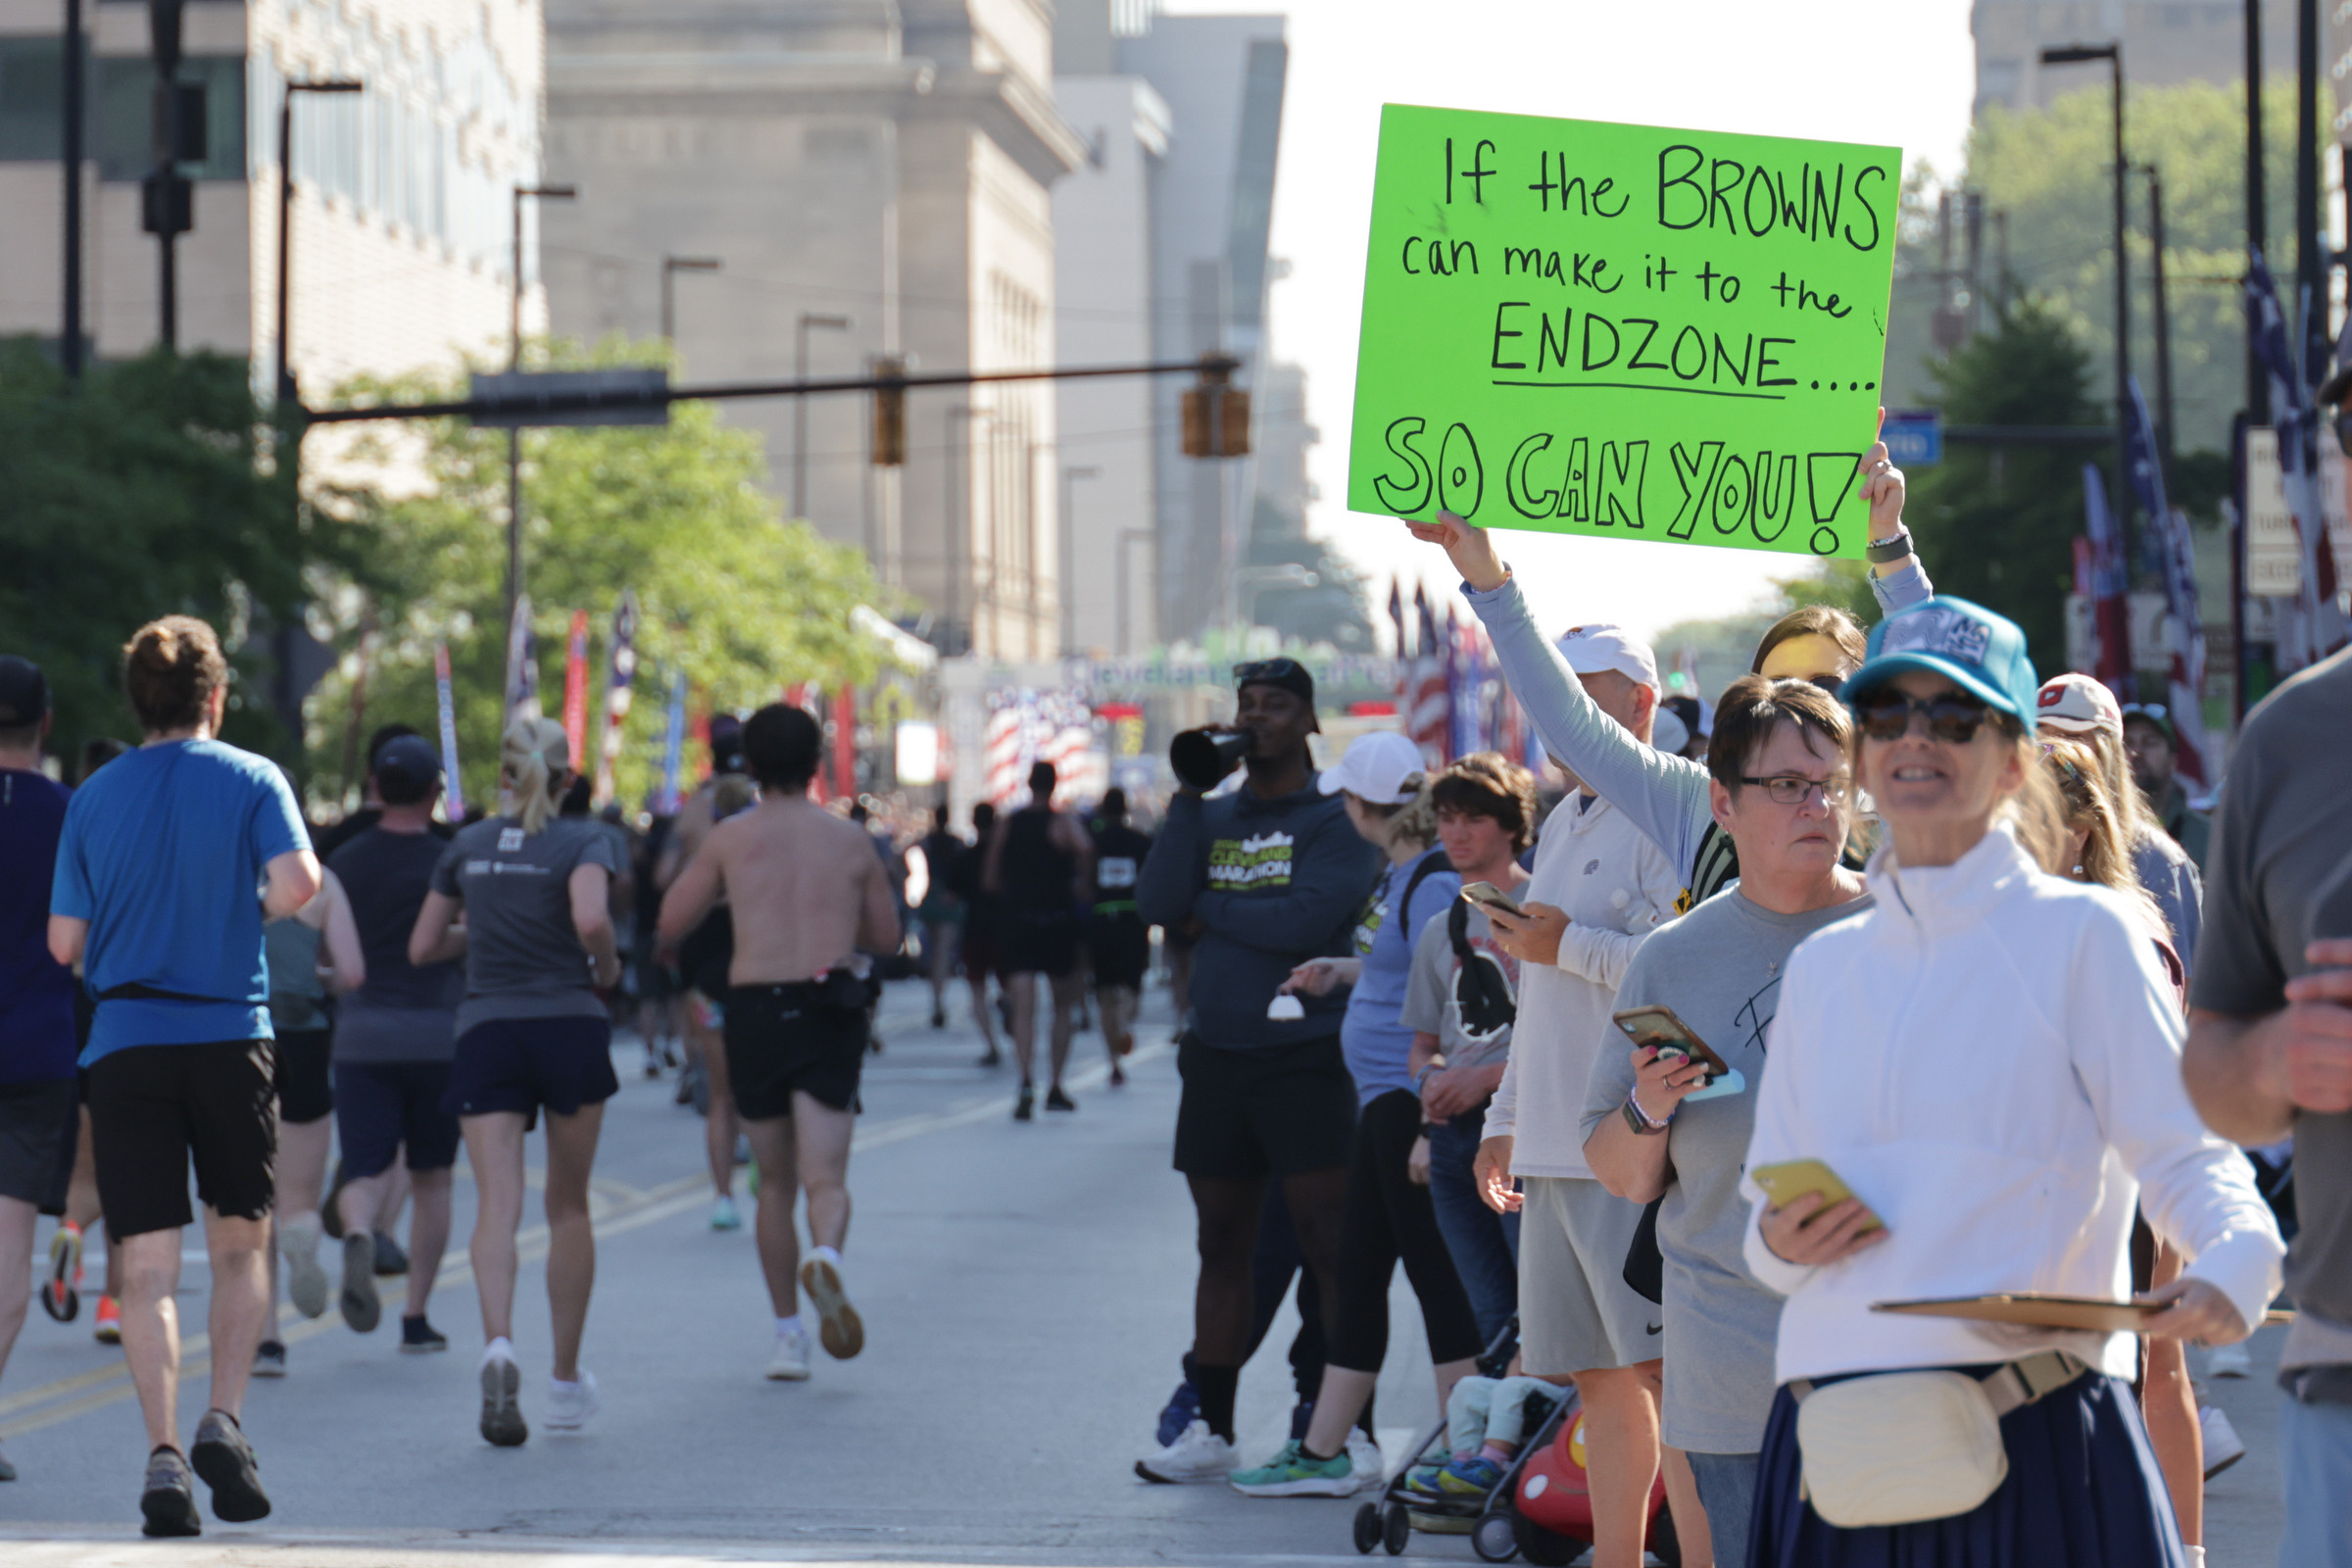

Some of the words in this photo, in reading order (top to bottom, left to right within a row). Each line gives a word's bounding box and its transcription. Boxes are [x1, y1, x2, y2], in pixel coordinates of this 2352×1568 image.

[1446, 137, 1497, 205] If
[1528, 150, 1631, 219] the
[1657, 144, 1886, 252] BROWNS
[1402, 236, 1479, 276] can
[1504, 247, 1624, 294] make
[1645, 255, 1678, 292] it
[1695, 261, 1740, 304] to
[1770, 271, 1853, 318] the
[1373, 416, 1484, 519] SO
[1505, 432, 1650, 529] CAN
[1666, 440, 1863, 556] YOU!
[1207, 860, 1293, 883] MARATHON
